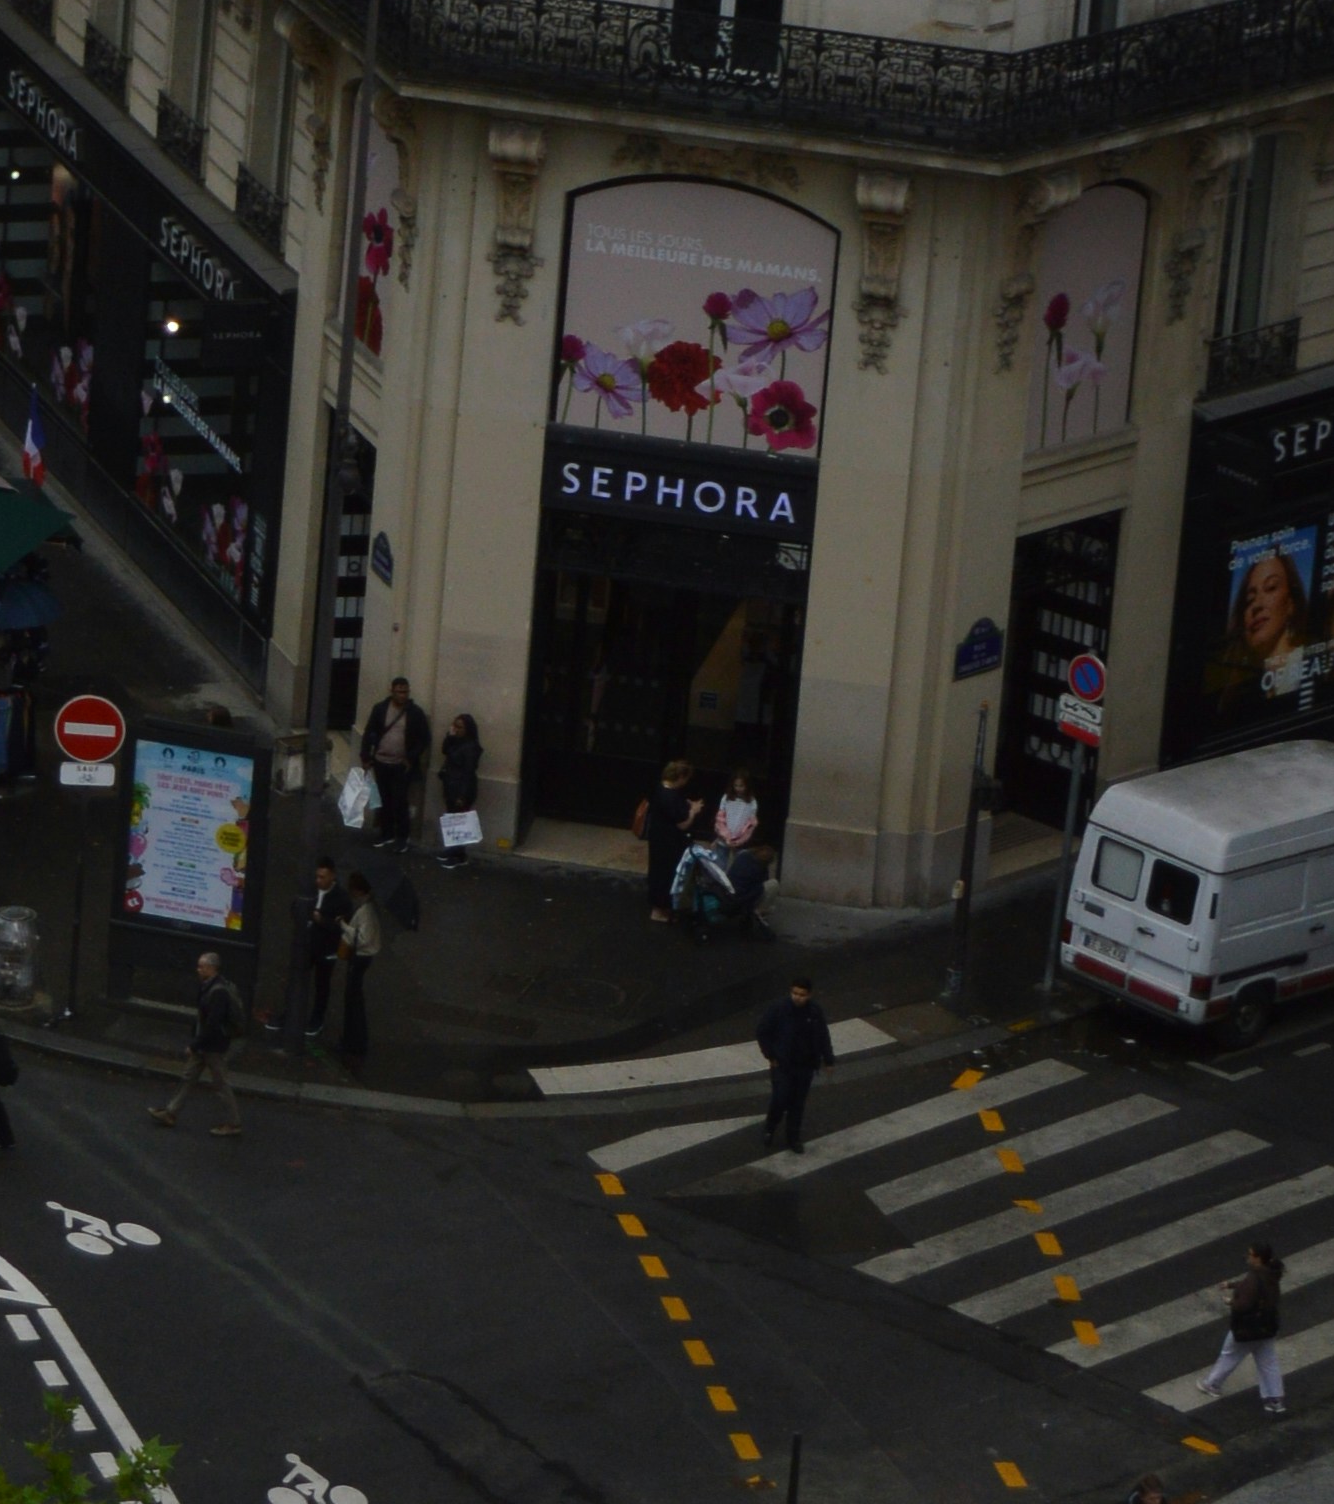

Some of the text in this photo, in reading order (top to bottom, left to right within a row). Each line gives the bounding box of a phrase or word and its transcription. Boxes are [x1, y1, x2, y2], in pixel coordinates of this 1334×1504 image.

[8, 69, 80, 161] SEPHORA
[586, 223, 628, 242] TOUS
[630, 229, 653, 244] LES
[159, 216, 237, 301] SEPHORA
[585, 239, 823, 283] LA MEILLEURE DES MAMANS.
[212, 330, 263, 340] SEPHORA
[560, 461, 796, 525] SEPHORA
[1229, 525, 1296, 555] Prenez soin
[1228, 556, 1245, 572] de
[1246, 548, 1277, 566] votre
